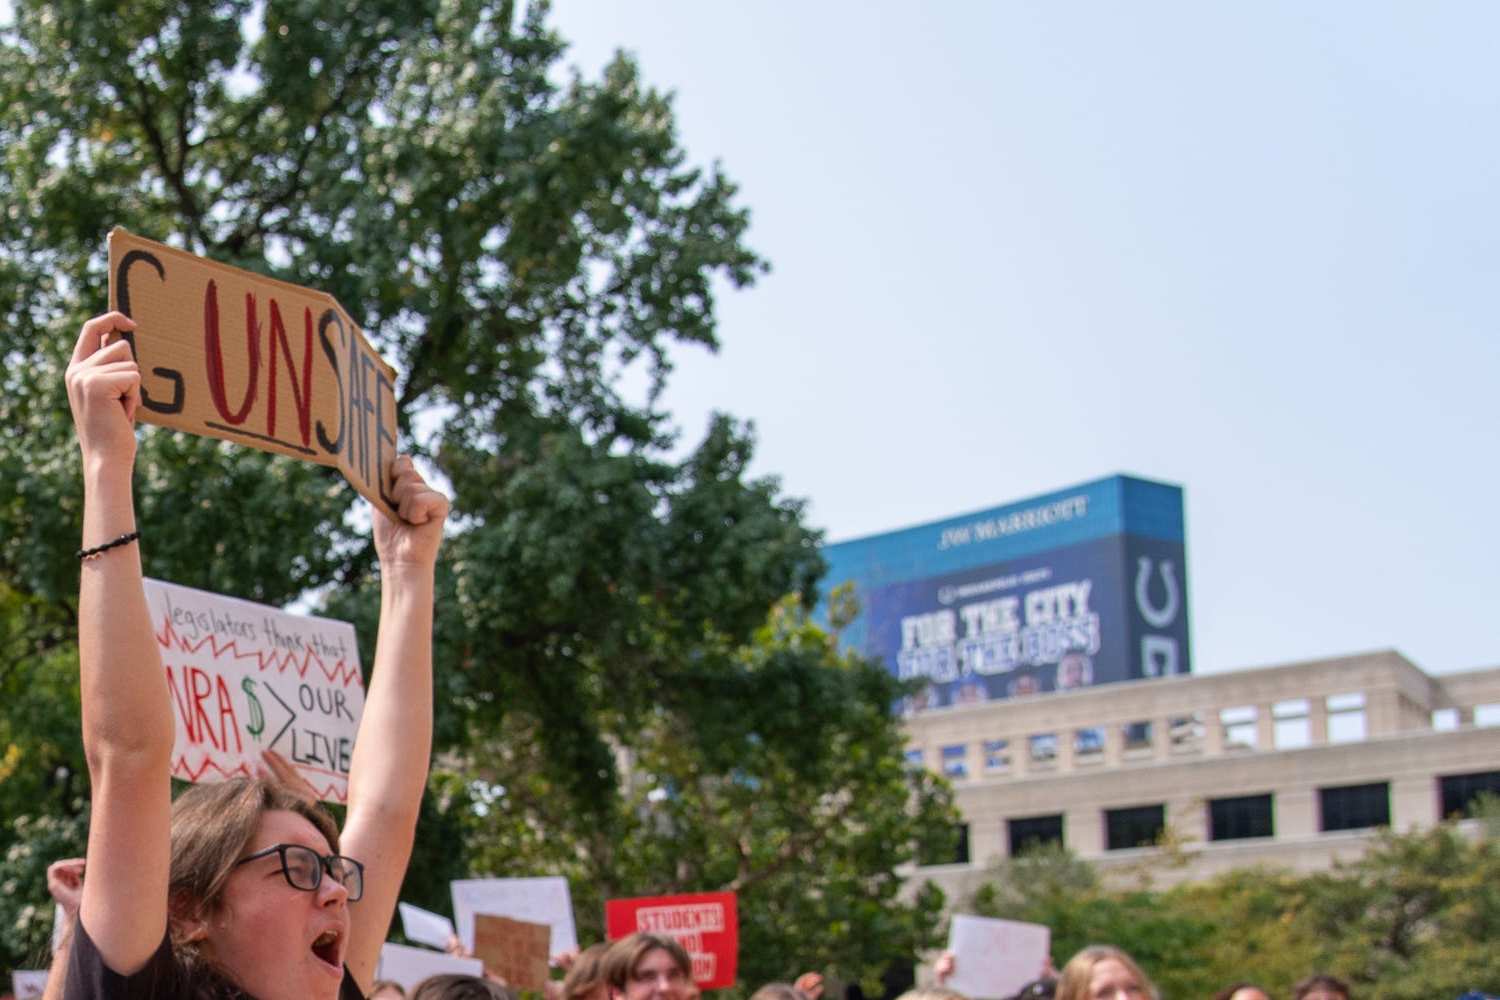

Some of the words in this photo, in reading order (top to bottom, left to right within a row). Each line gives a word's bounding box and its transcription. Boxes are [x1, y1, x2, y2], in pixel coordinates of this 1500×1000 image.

[973, 495, 1091, 541] MARRIOTT
[165, 588, 257, 642] legislators
[264, 616, 305, 651] think
[312, 634, 349, 661] that
[902, 610, 956, 650] FOR
[960, 597, 1019, 638] THE
[1024, 579, 1092, 626] CITY
[167, 665, 243, 753] NRA
[299, 683, 354, 722] OUR
[292, 729, 355, 773] LIVE
[640, 908, 720, 931] STUDENTS
